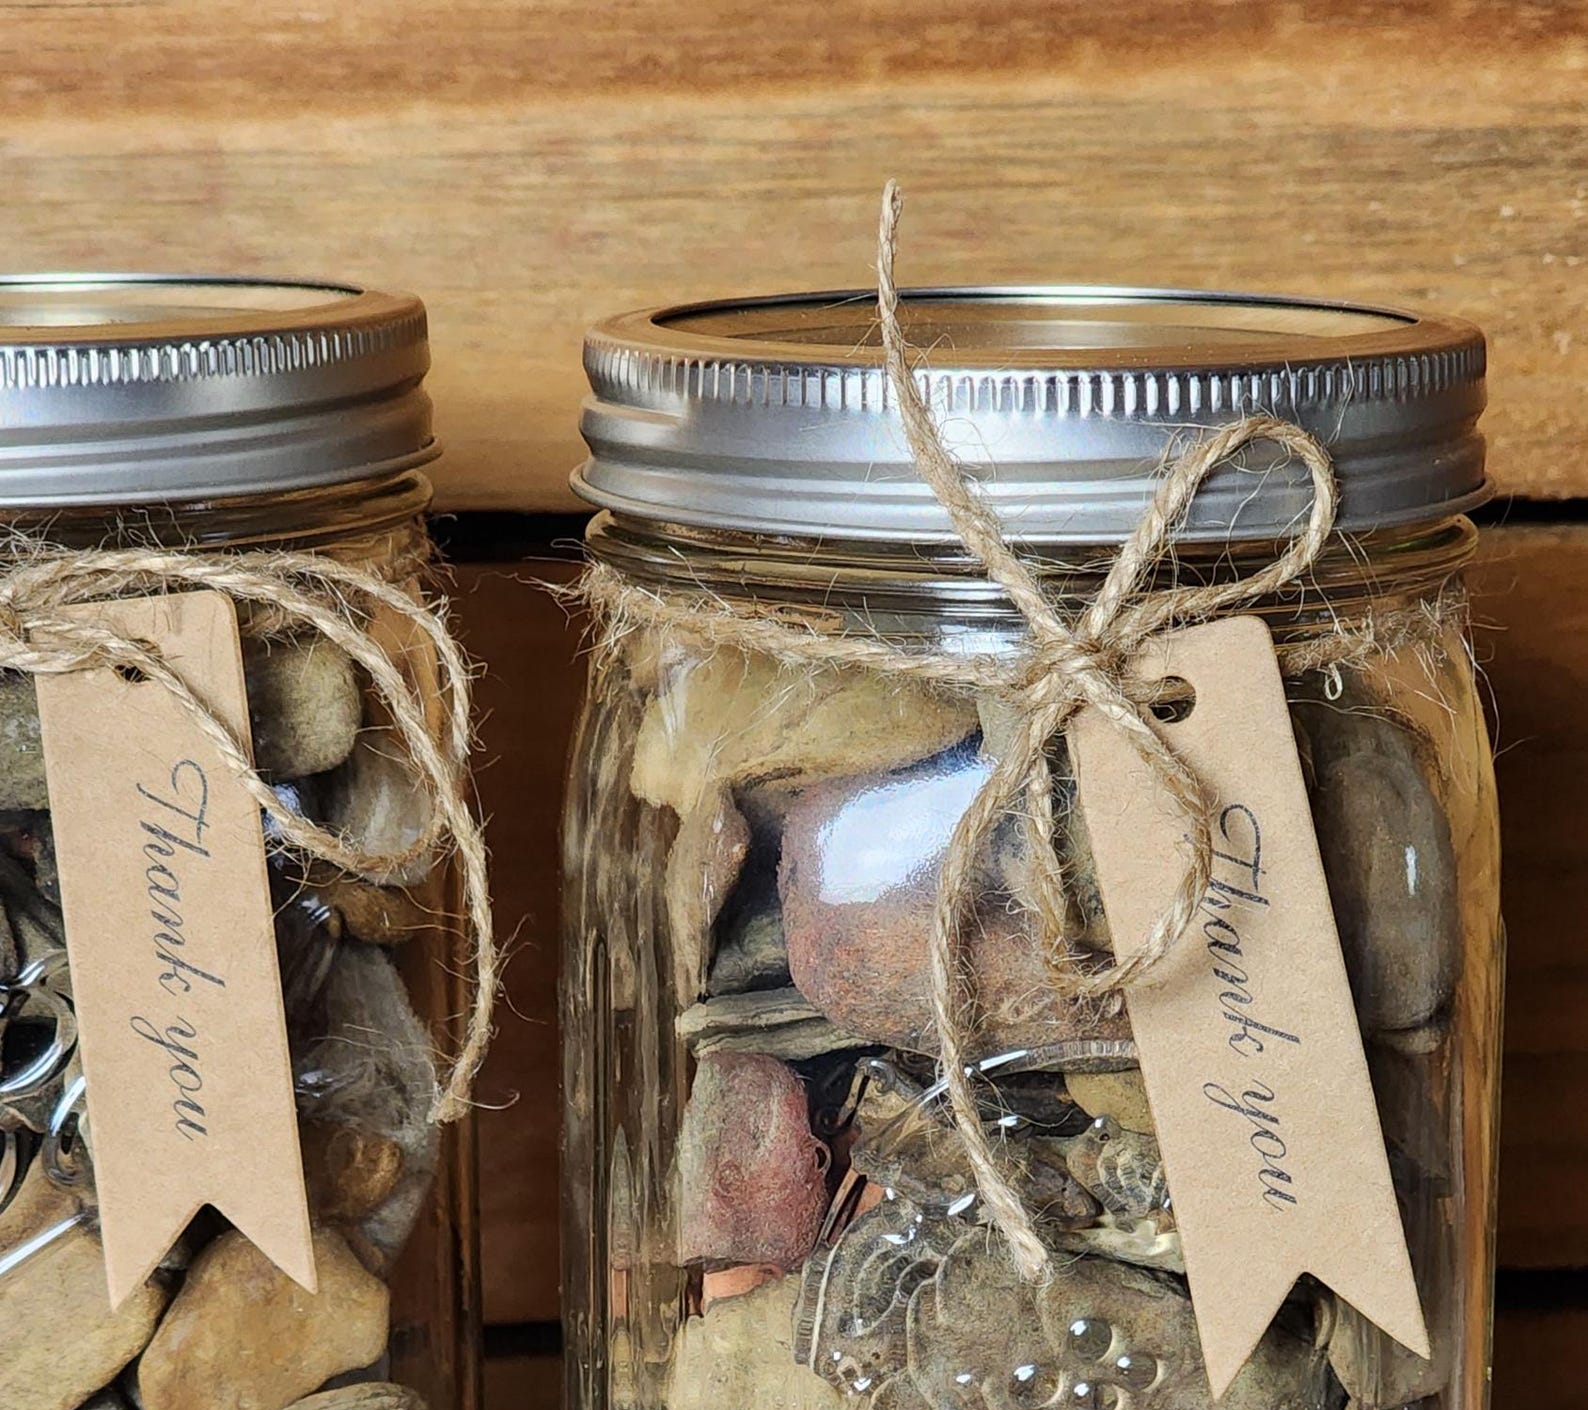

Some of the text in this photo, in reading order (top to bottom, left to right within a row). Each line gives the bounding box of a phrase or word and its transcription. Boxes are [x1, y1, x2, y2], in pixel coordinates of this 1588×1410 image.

[130, 758, 226, 1142] Thank you
[1184, 803, 1301, 1213] Thank you
